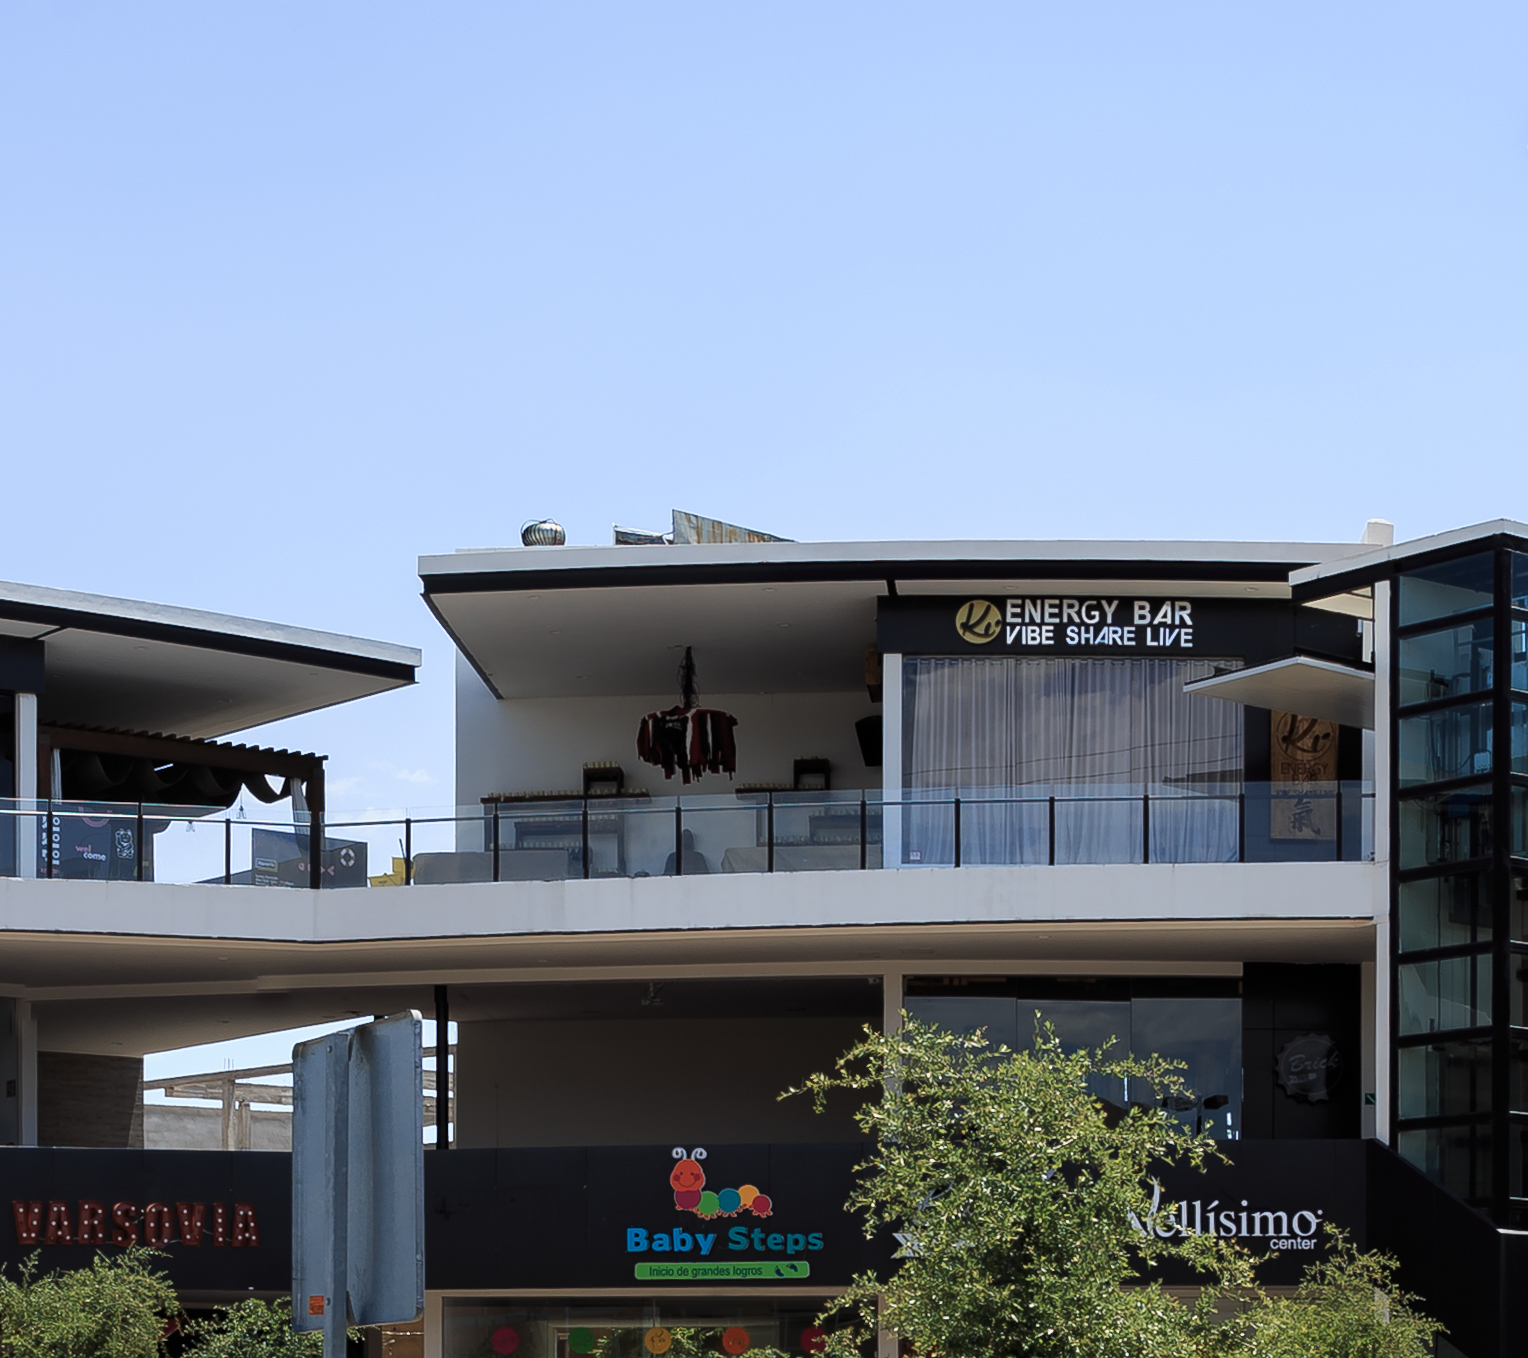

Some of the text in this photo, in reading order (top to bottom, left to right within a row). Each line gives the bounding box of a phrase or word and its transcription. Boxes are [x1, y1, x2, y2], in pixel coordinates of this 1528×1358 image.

[1006, 599, 1193, 625] ENERGY BAR
[1006, 625, 1193, 647] VIBE SHARE LIVE
[1280, 762, 1329, 775] ENERGY
[12, 1200, 261, 1248] VARSOVIA
[626, 1226, 824, 1256] Baby Steps
[1269, 1237, 1318, 1250] center
[649, 1265, 763, 1280] Inicio de grandes logros
